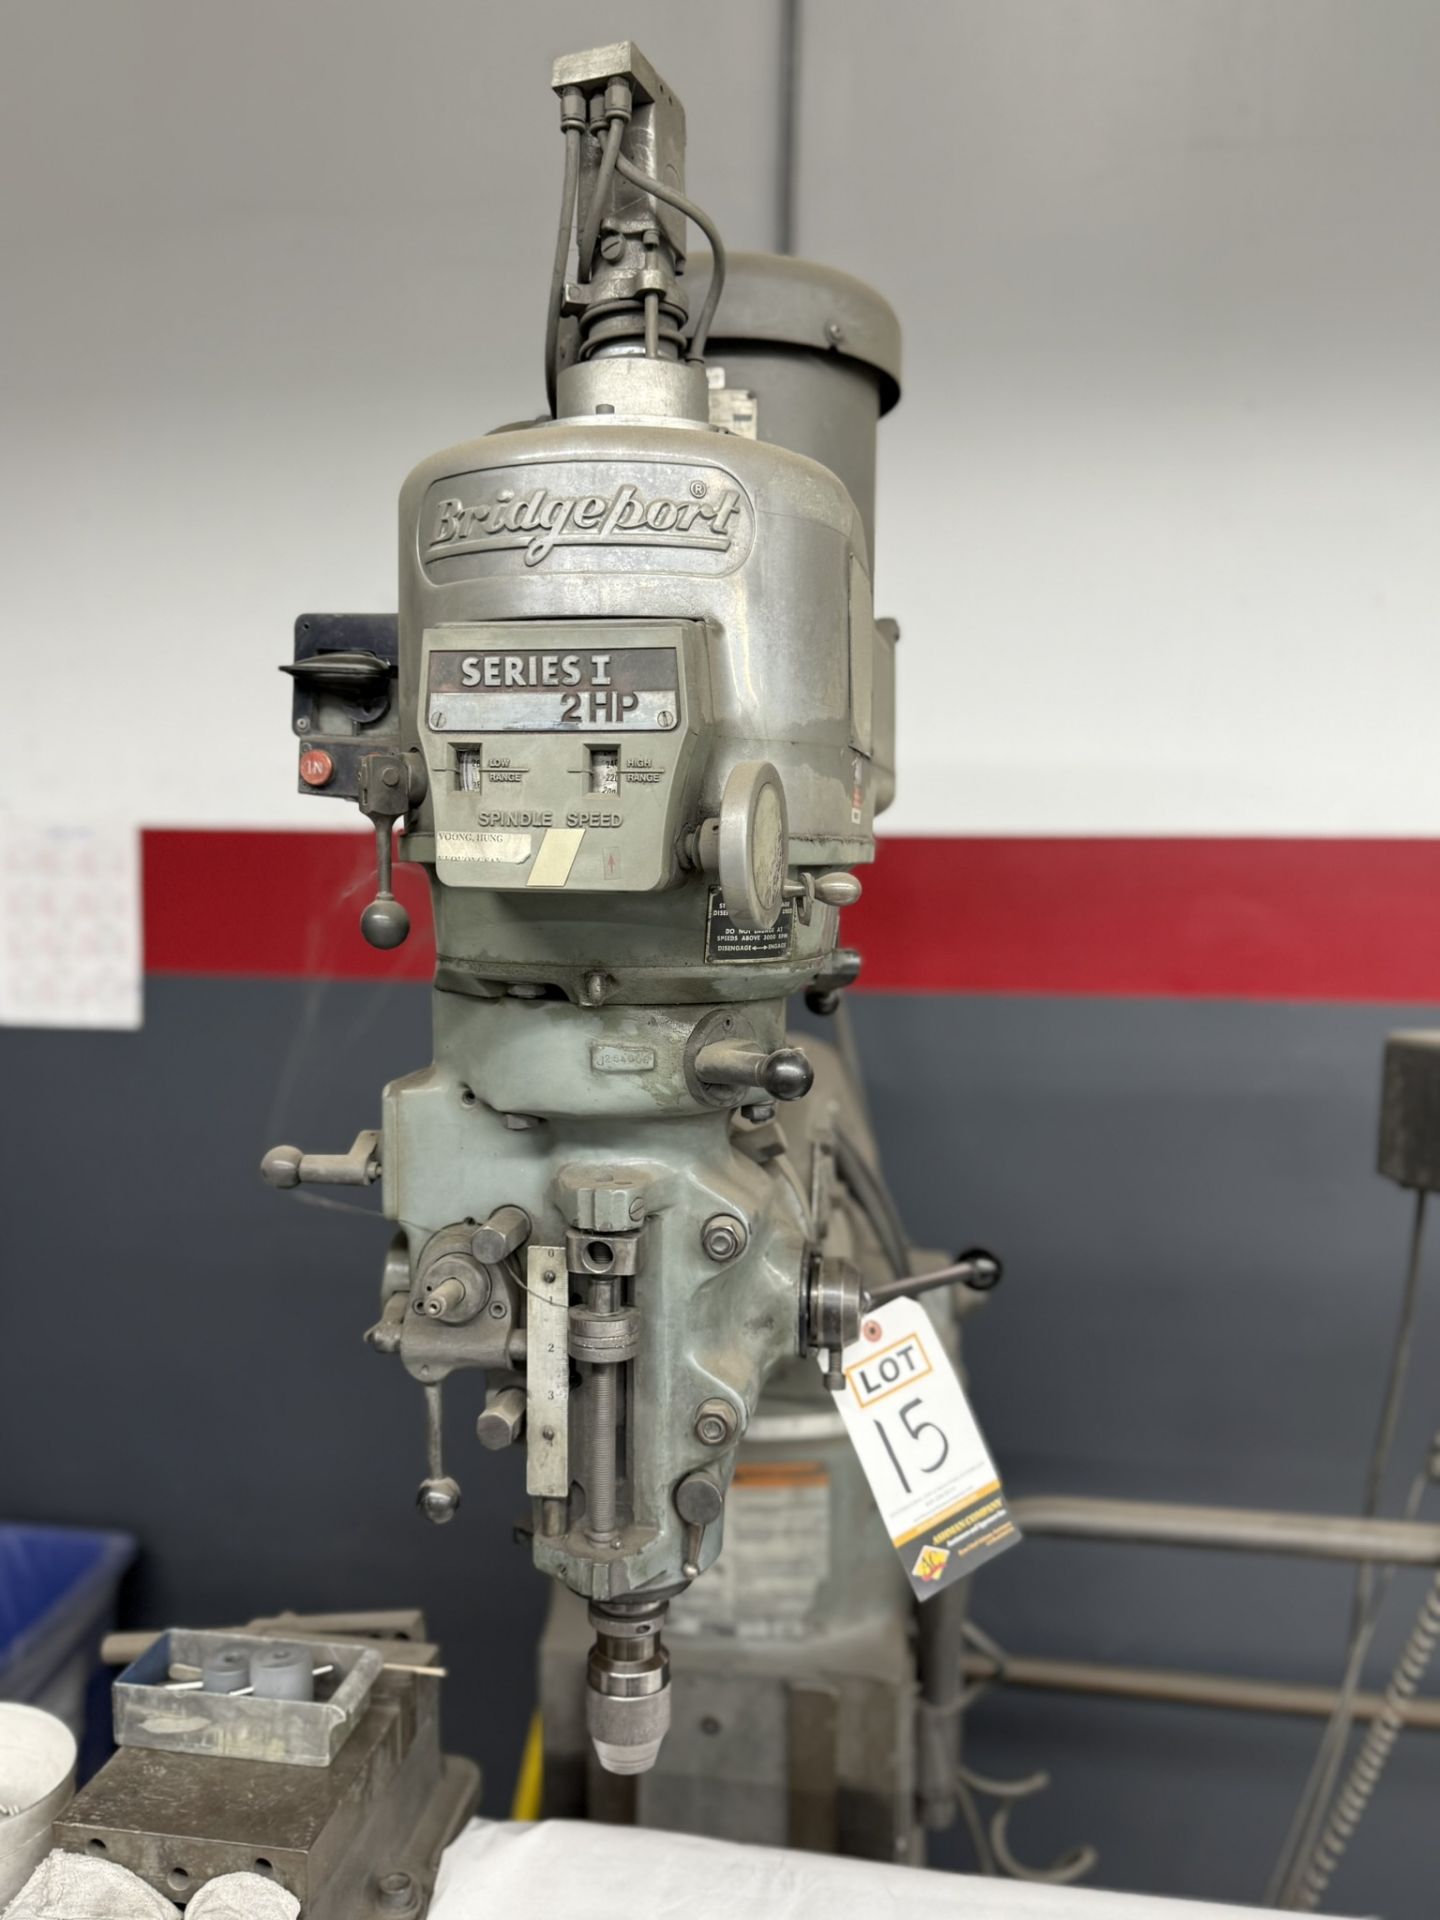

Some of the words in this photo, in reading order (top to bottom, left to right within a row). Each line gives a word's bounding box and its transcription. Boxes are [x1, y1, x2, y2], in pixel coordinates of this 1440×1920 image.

[430, 484, 741, 567] Bridgeport
[462, 655, 581, 686] SERIES
[488, 759, 511, 768] LOW
[626, 759, 652, 768] HIGH
[489, 773, 522, 782] RANGE
[626, 774, 660, 783] RANGE
[478, 811, 553, 828] SPINDLE
[566, 811, 623, 828] SPEED
[548, 1343, 554, 1352] 2
[859, 1345, 915, 1394] LOT
[548, 1390, 554, 1400] 3
[873, 1397, 949, 1494] 15
